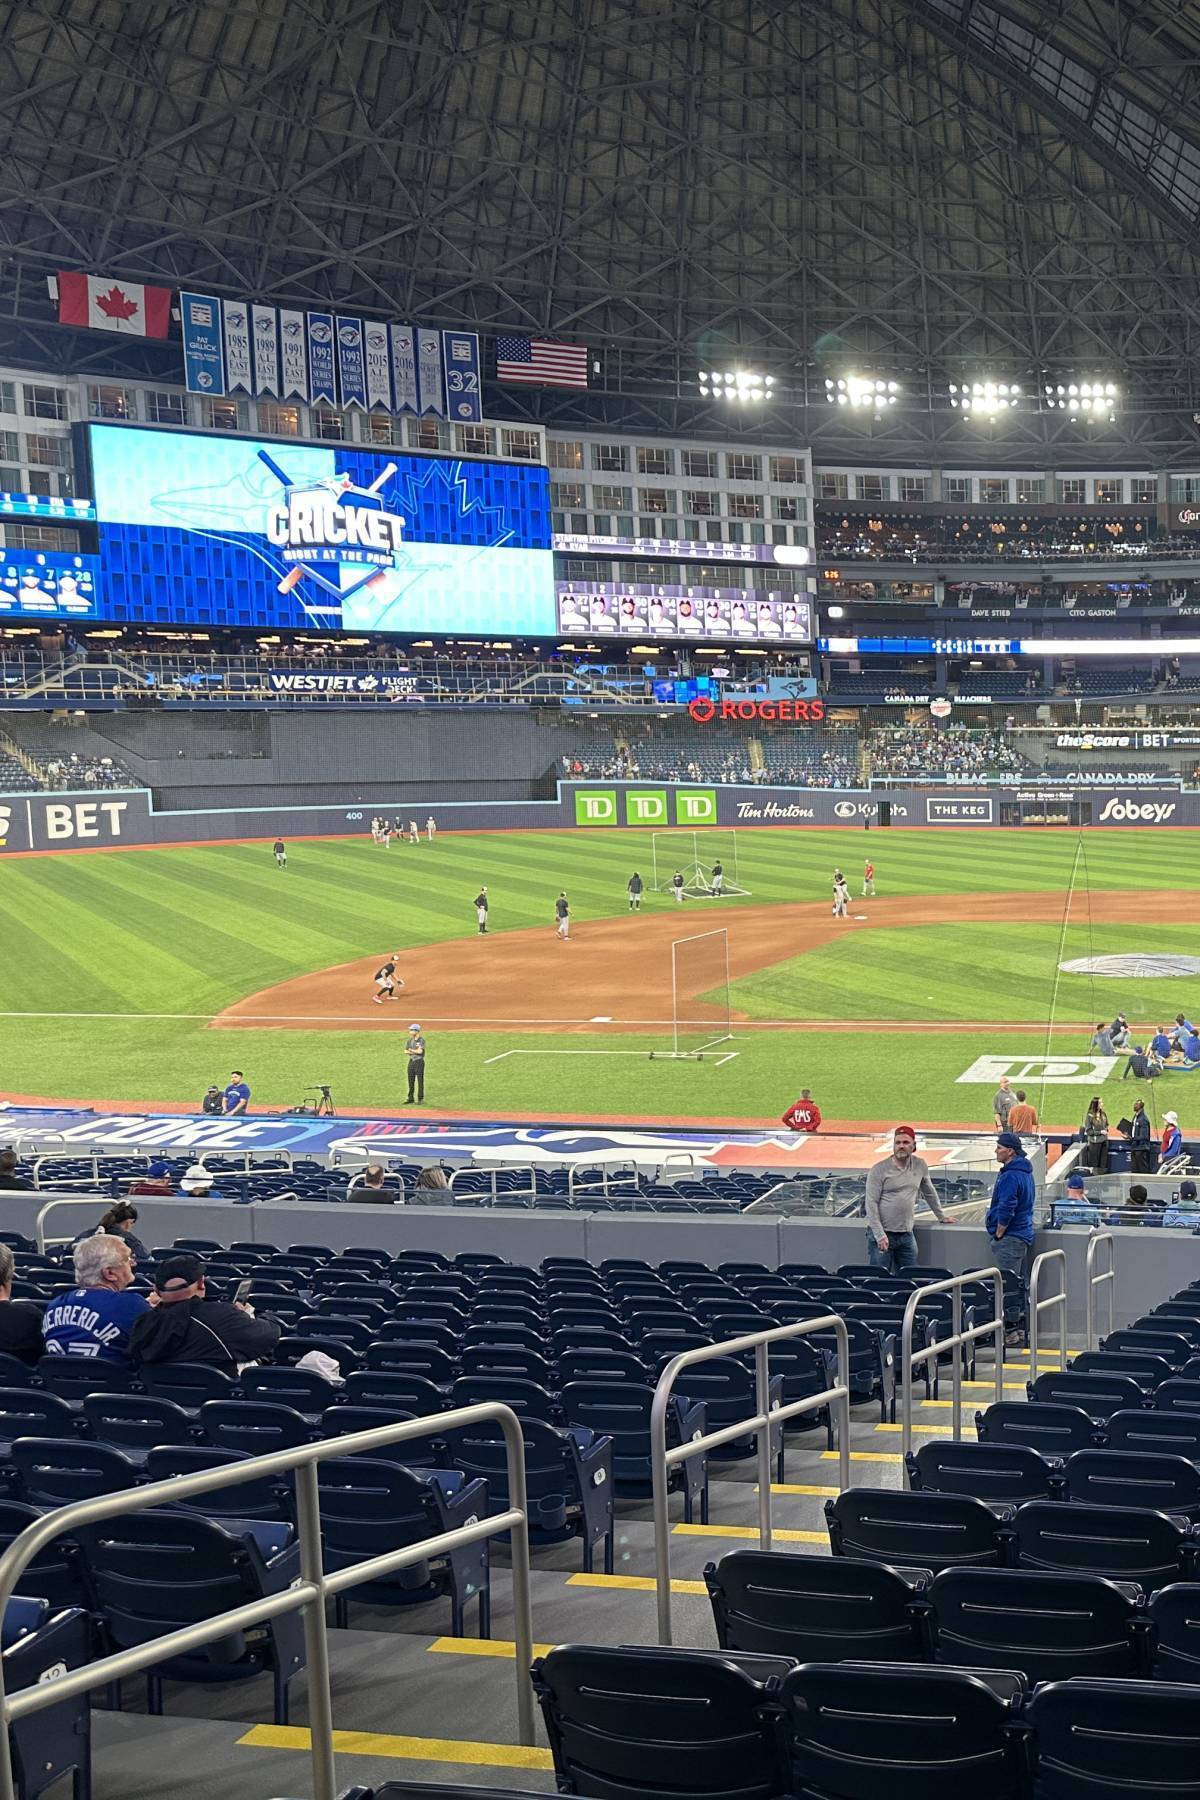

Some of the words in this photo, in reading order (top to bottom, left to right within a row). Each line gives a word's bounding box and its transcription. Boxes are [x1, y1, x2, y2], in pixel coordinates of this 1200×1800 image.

[196, 336, 208, 344] PAT
[228, 334, 247, 349] 1985
[256, 338, 275, 352] 1989
[284, 343, 303, 357] 1991
[312, 346, 332, 360] 1992
[341, 350, 361, 364] 1993
[229, 360, 249, 370] EAST
[368, 353, 388, 366] 2015
[395, 356, 414, 369] 2016
[257, 364, 276, 374] EAST
[285, 368, 305, 378] EAST
[447, 370, 479, 393] 32
[267, 502, 406, 550] CRICKET
[323, 549, 336, 560] AT
[341, 550, 362, 561] THE
[46, 569, 54, 580] 7
[75, 571, 91, 582] 28
[1088, 609, 1116, 617] GASTON
[271, 674, 357, 689] WESTJET
[382, 677, 418, 686] FLIGHT
[884, 695, 914, 703] CANADA
[915, 695, 930, 703] DRY
[953, 695, 992, 703] BLEACHERS
[721, 700, 824, 720] ROGERS
[1056, 734, 1130, 747] theScore
[1143, 734, 1170, 747] BET
[946, 772, 1023, 784] BLEACERS
[1066, 773, 1115, 784] CANADA
[1120, 773, 1155, 784] DRY
[580, 797, 613, 818] TD
[630, 797, 663, 818] TD
[680, 796, 712, 817] TD
[736, 802, 762, 818] Tim
[763, 802, 815, 818] Hortons
[935, 806, 958, 814] THE
[962, 806, 985, 814] KEG
[1100, 797, 1176, 823] Sobeys
[47, 802, 127, 840] BET
[346, 811, 363, 821] 400
[990, 1060, 1097, 1078] TD
[794, 1109, 811, 1123] EMS
[44, 1116, 294, 1148] CORE
[93, 1322, 121, 1346] JR.
